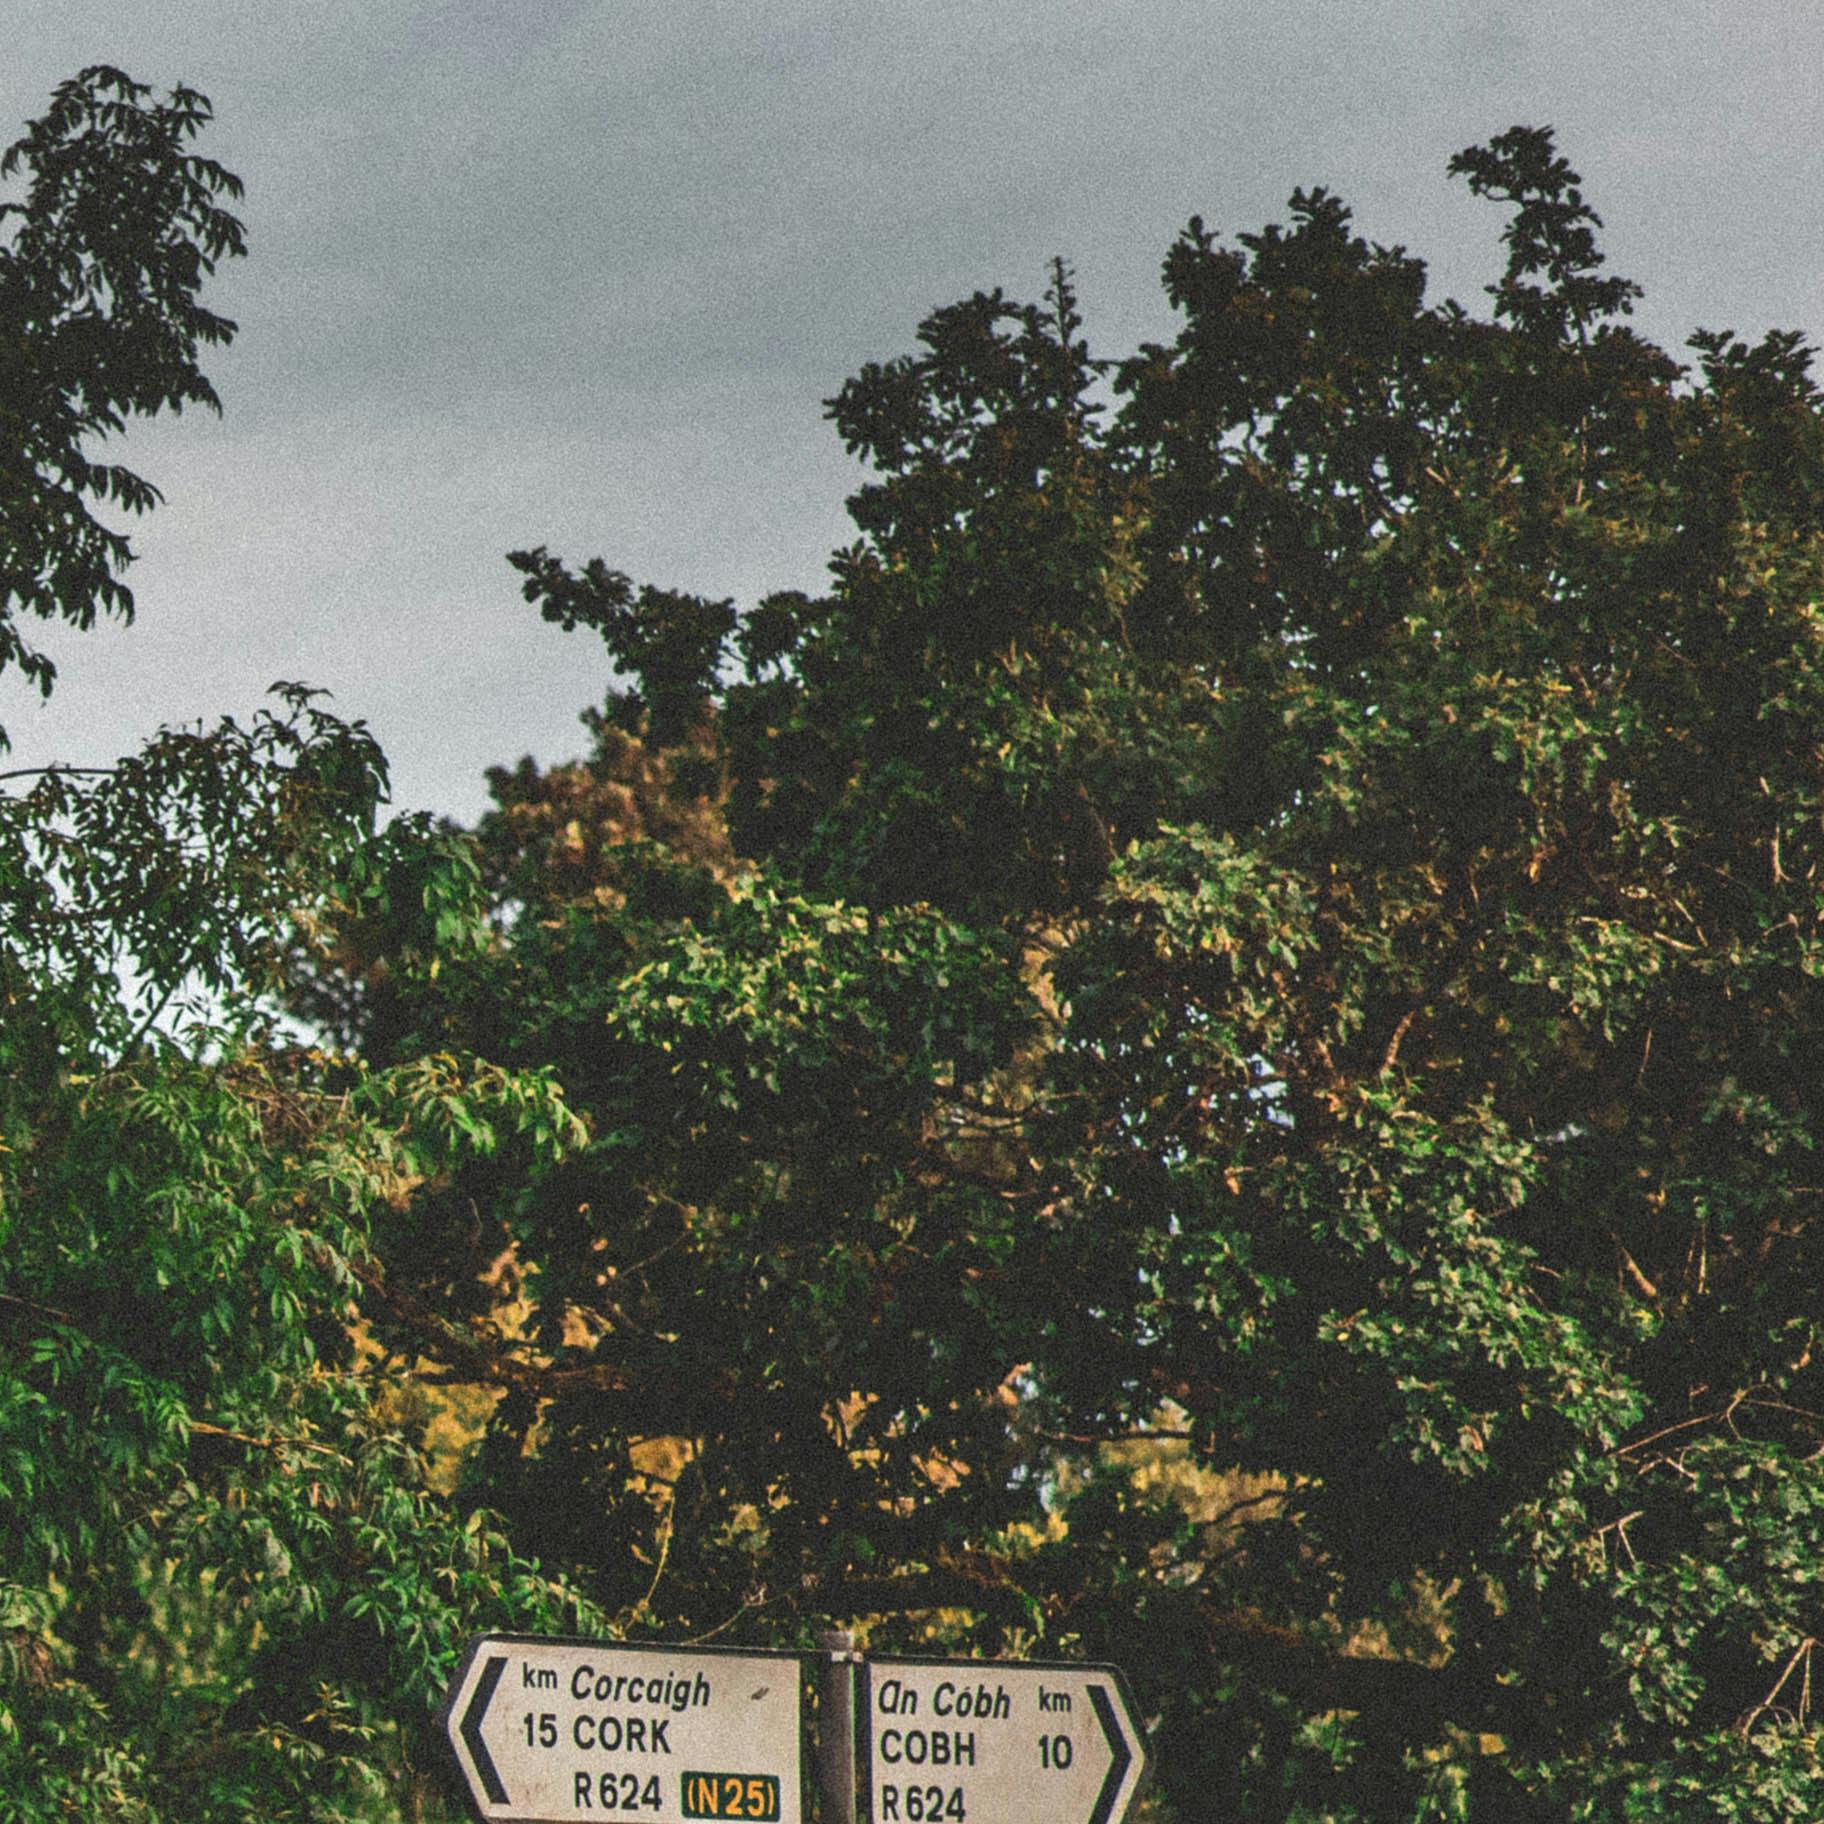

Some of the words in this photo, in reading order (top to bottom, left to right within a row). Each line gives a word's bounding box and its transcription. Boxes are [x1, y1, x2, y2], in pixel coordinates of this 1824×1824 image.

[522, 1662, 558, 1690] km
[570, 1665, 711, 1713] Corcaigh
[878, 1679, 918, 1715] An
[933, 1682, 1010, 1719] Cóbh
[1038, 1685, 1072, 1712] km
[523, 1713, 558, 1748] 15
[573, 1715, 672, 1754] CORK
[880, 1729, 976, 1766] COBH
[1038, 1735, 1073, 1770] 10
